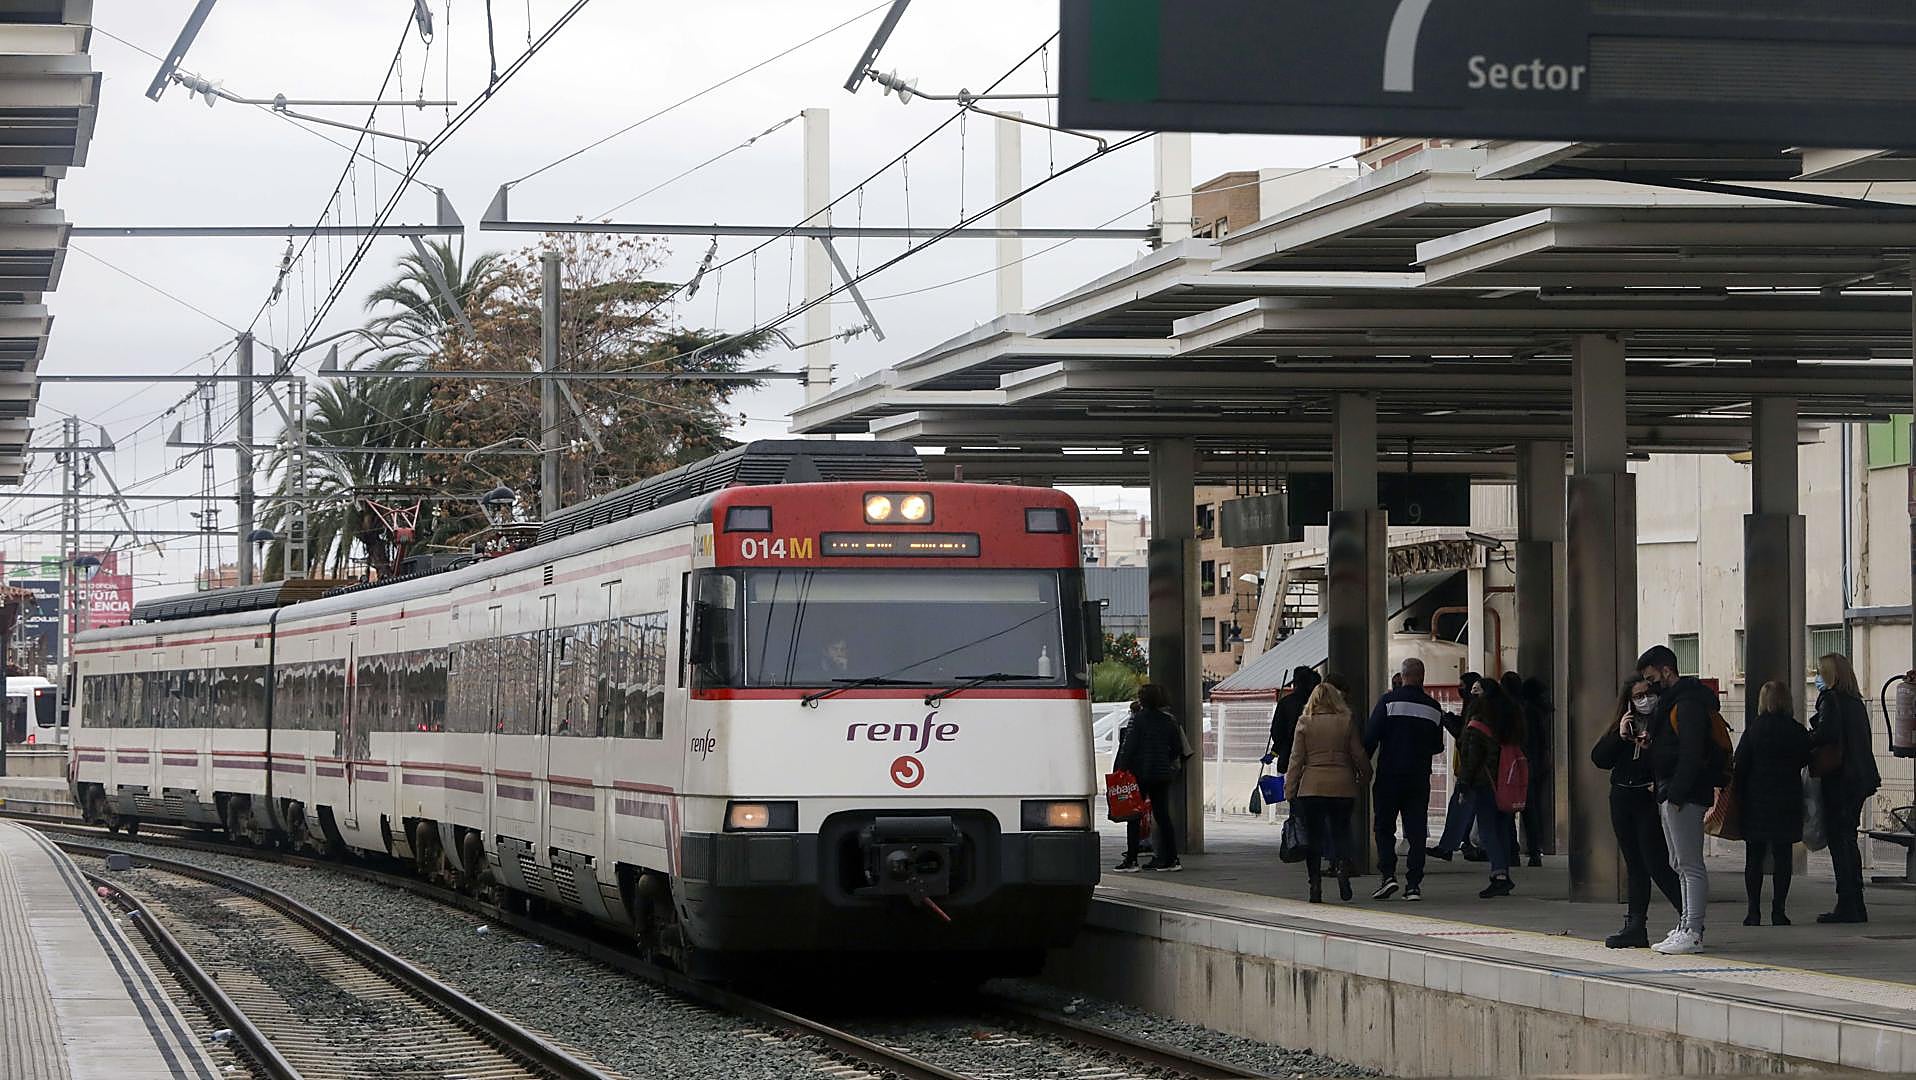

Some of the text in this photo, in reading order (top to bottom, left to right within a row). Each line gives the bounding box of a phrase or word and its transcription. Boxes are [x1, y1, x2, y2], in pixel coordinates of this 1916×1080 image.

[1467, 55, 1586, 90] Sector
[1408, 503, 1422, 524] 9
[741, 537, 813, 559] 014M
[71, 601, 130, 612] LENCIA
[690, 728, 716, 761] renfe
[846, 711, 960, 754] renfe
